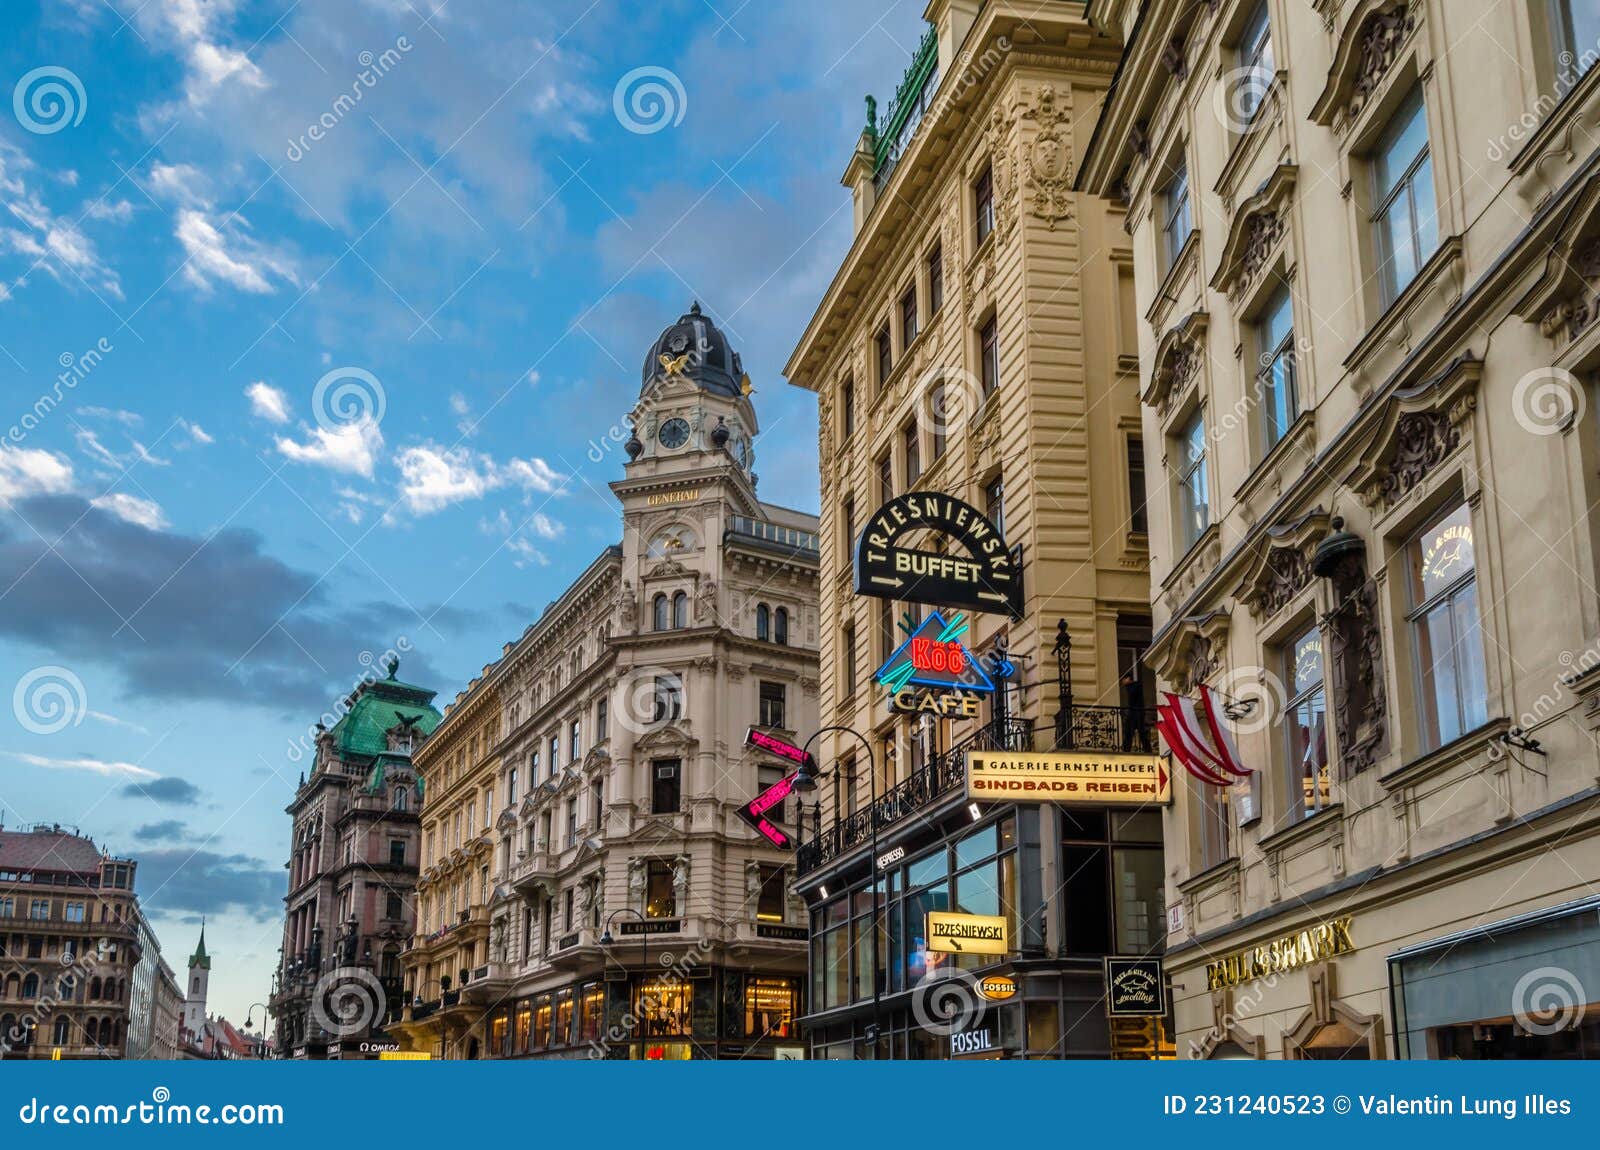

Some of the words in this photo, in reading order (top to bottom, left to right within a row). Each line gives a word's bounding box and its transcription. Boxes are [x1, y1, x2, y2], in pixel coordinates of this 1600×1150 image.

[647, 489, 699, 505] GENERALI
[896, 551, 982, 583] BUFFET
[912, 637, 966, 675] Köö
[990, 761, 1049, 771] GALERIE
[1055, 763, 1099, 772] ERNST
[1104, 764, 1155, 773] HILGER
[973, 780, 1078, 792] SINDBADS
[1086, 782, 1156, 793] REISEN
[933, 923, 1003, 940] TRZEŚNIEWSKI
[1206, 952, 1252, 991] PAUL
[1252, 947, 1270, 976] &
[1270, 916, 1355, 971] SHARK
[983, 984, 1016, 992] FOSSIL
[951, 1029, 991, 1053] FOSSIL
